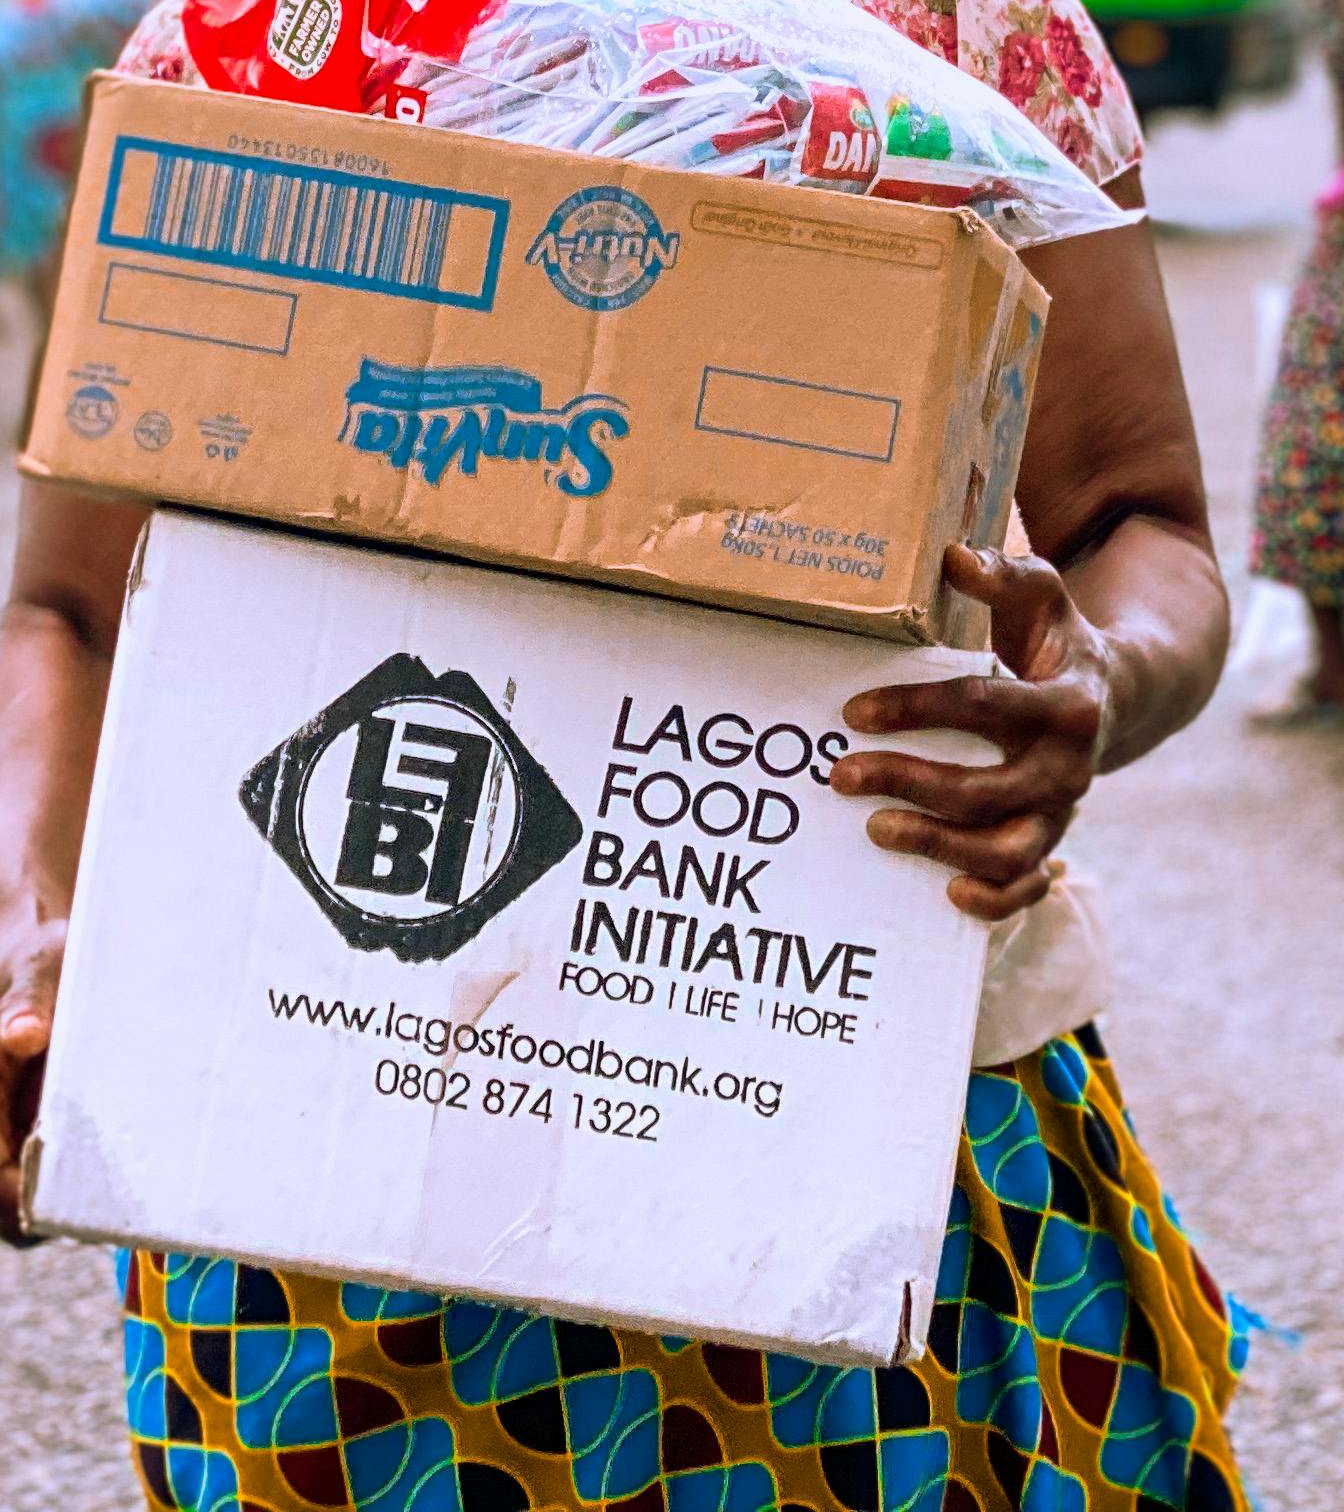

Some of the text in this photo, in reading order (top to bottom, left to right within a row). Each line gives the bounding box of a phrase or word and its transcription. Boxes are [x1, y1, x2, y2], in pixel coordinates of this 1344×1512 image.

[288, 62, 314, 79] FROM
[316, 39, 332, 67] COW
[330, 18, 340, 36] TO
[289, 0, 323, 57] FARMER
[301, 8, 332, 63] OWNED
[354, 408, 630, 497] SunVita
[786, 549, 823, 569] NET
[812, 528, 836, 546] 50
[827, 555, 884, 580] POIDS
[853, 531, 888, 556] 30g
[612, 696, 849, 786] LAGOS
[597, 762, 800, 845] FOOD
[582, 830, 771, 914] BANK
[570, 898, 877, 1001] INITIATIVE
[558, 961, 858, 1044] FOOD LIFE HOPE
[268, 989, 784, 1117] www.lagosfoodbank.org
[374, 1059, 662, 1143] 0802 874 1322
